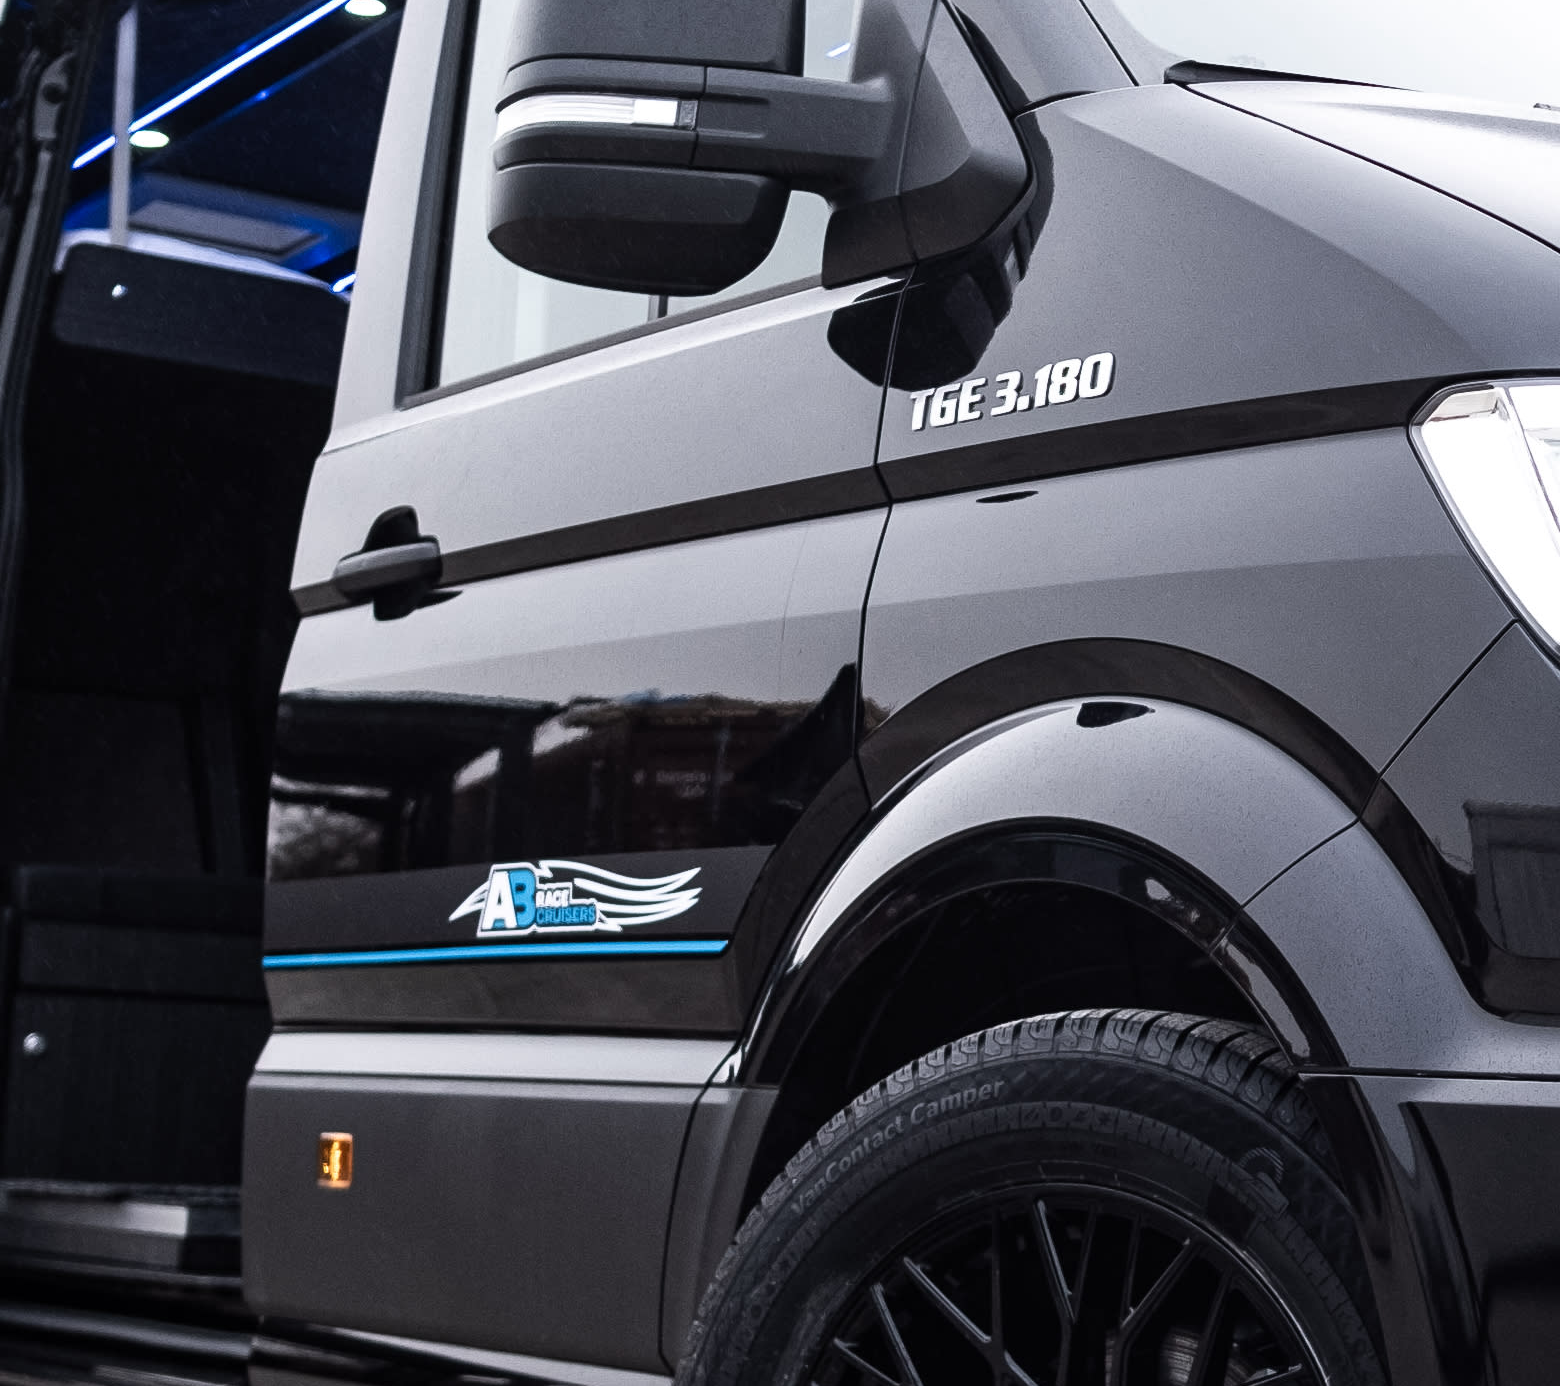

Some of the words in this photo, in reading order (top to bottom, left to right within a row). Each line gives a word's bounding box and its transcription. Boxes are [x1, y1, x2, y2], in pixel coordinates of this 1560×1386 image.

[910, 377, 988, 431] TGE
[990, 352, 1115, 416] 3.180
[481, 868, 537, 930] AB
[536, 906, 596, 925] CRUISERS
[791, 1115, 905, 1213] VanContact
[910, 1078, 1005, 1125] Camper
